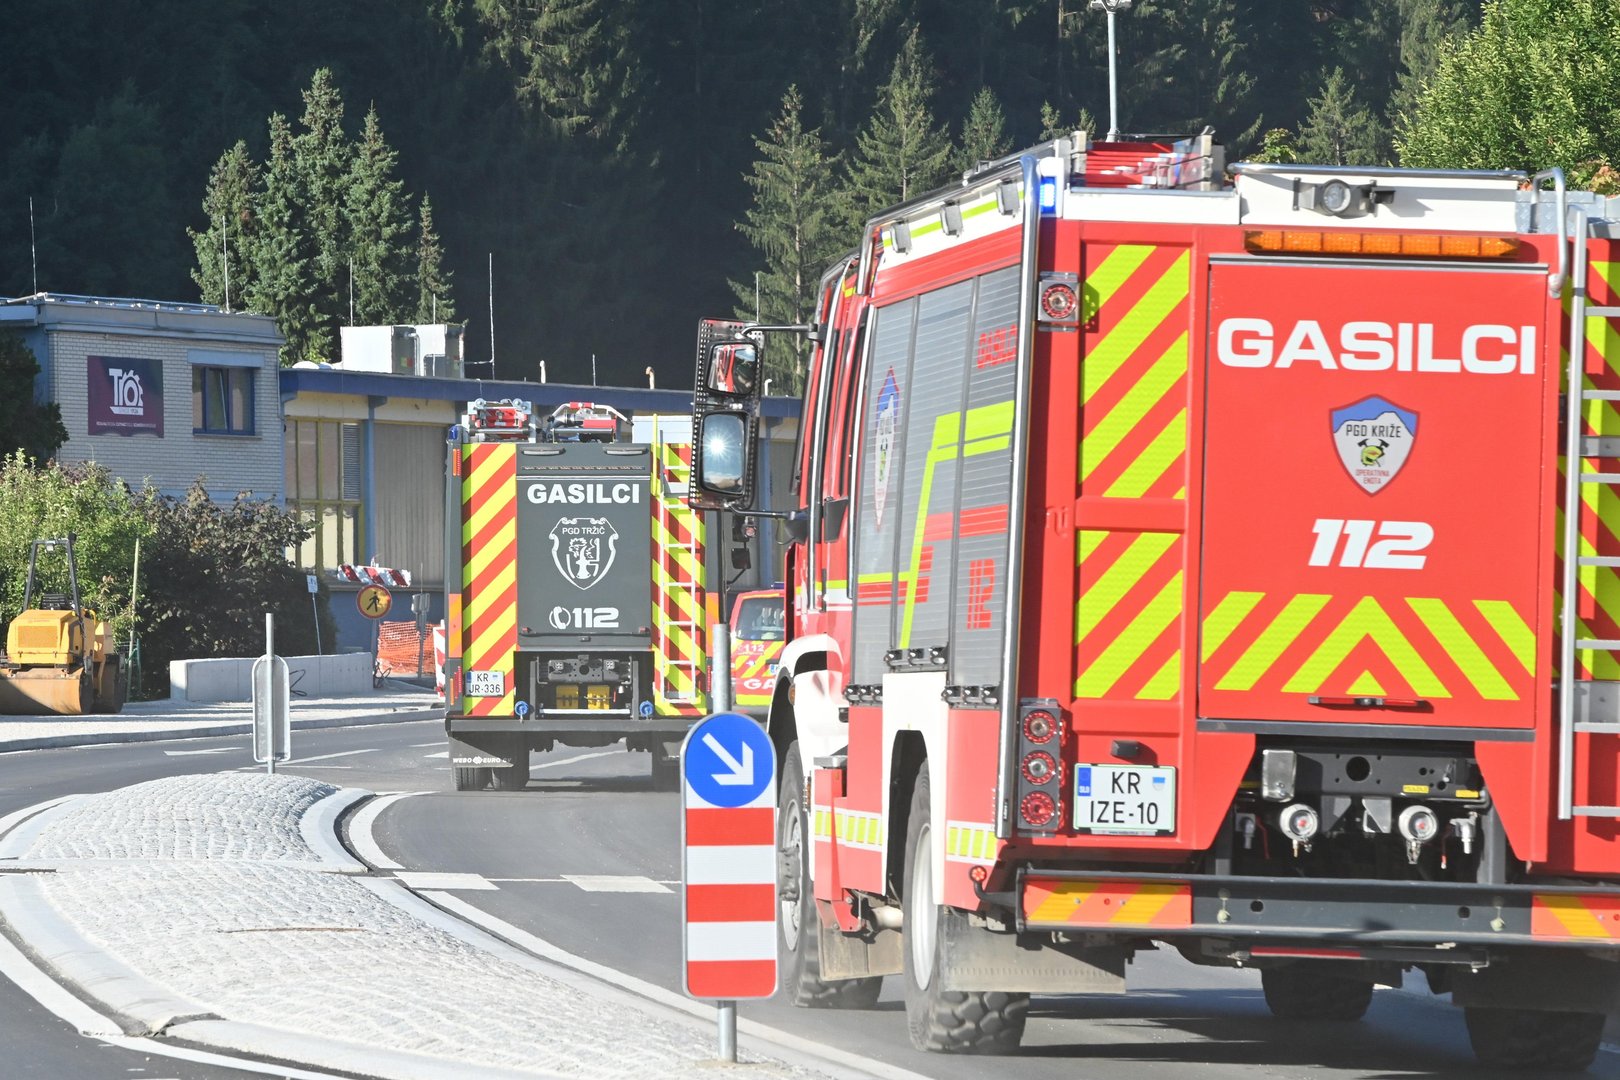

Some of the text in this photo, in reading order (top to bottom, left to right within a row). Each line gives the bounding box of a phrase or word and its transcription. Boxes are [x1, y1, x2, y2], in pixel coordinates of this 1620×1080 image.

[1217, 317, 1537, 375] GASILCI
[1345, 423, 1402, 438] PGD KRIŽE
[527, 483, 640, 504] GASILCI
[562, 525, 606, 535] PGD TRŽIČ
[1308, 518, 1435, 570] 112
[572, 607, 620, 629] 112
[742, 644, 765, 653] 112
[476, 673, 489, 682] KR
[469, 684, 501, 693] JR-336
[1111, 771, 1141, 795] KR
[1090, 800, 1159, 825] IZE-10
